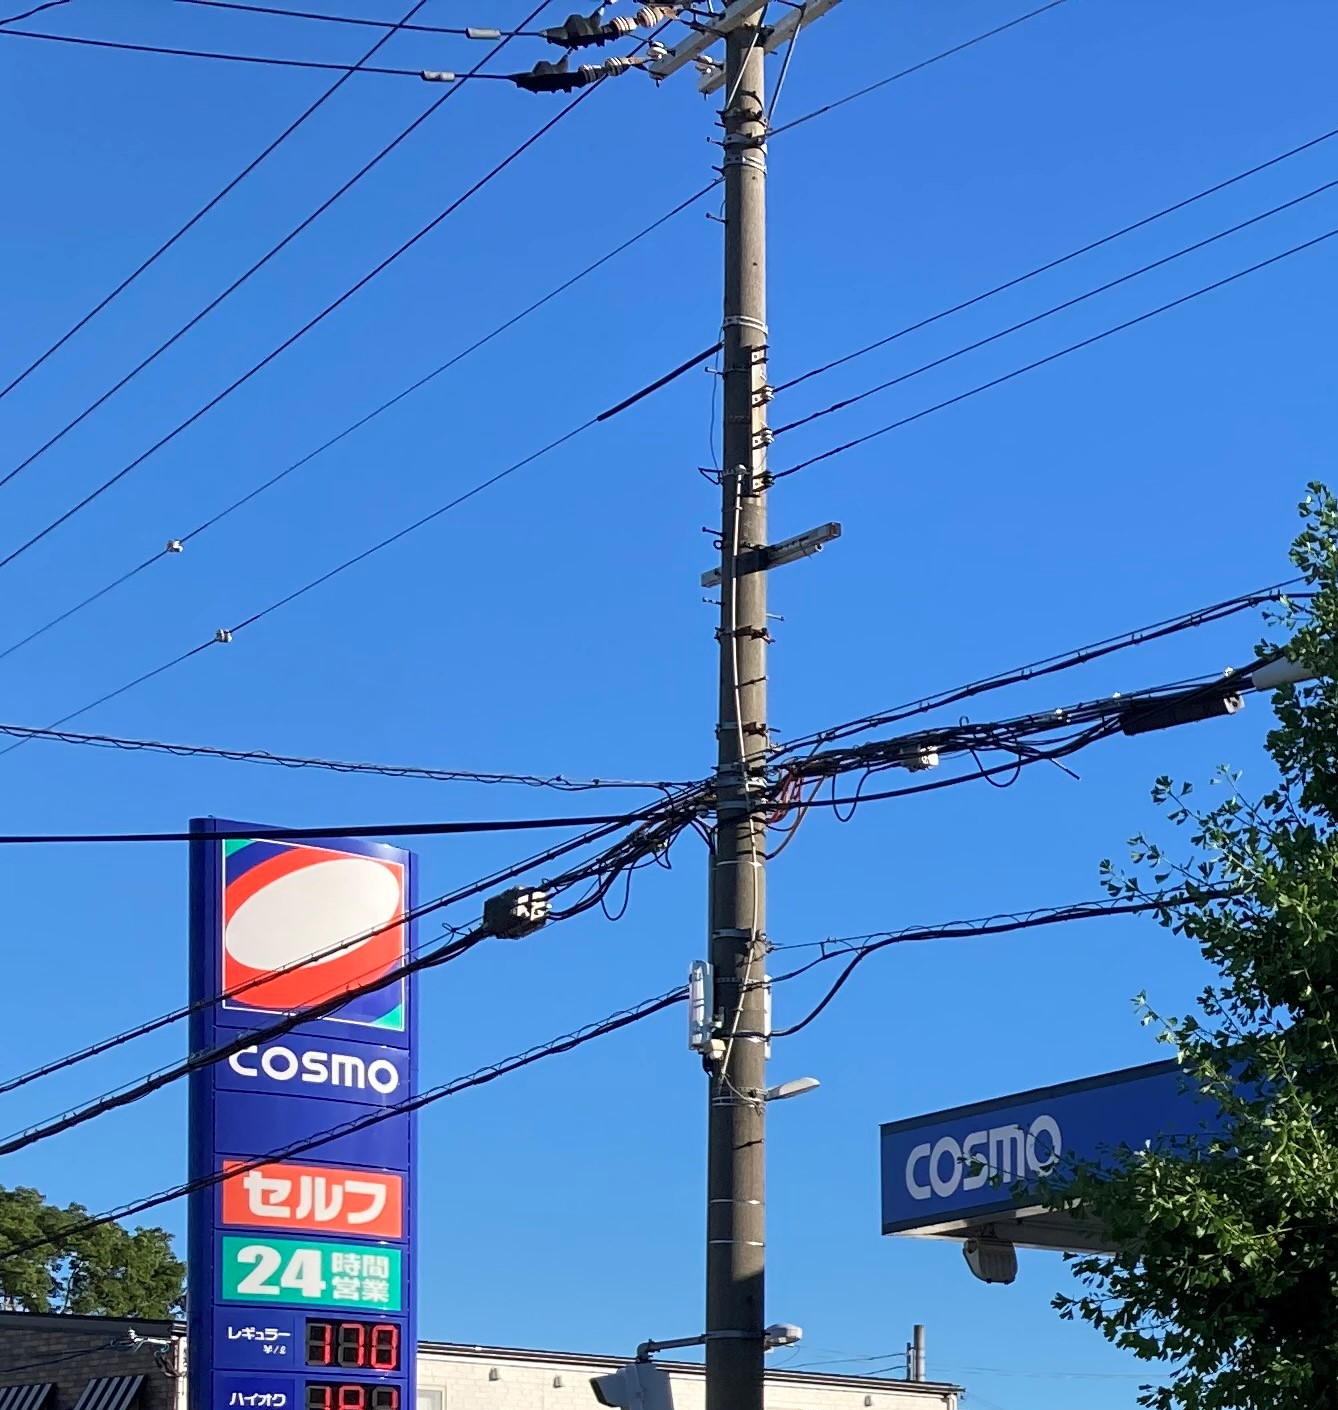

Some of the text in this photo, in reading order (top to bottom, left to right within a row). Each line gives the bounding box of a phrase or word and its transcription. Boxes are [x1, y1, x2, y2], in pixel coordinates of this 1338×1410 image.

[228, 1046, 398, 1093] COSMO
[905, 1115, 1062, 1200] COSMO
[243, 1170, 386, 1224] セルフ
[228, 1327, 290, 1341] レギュラー
[324, 1324, 398, 1369] 170
[229, 1393, 286, 1407] ハイオク
